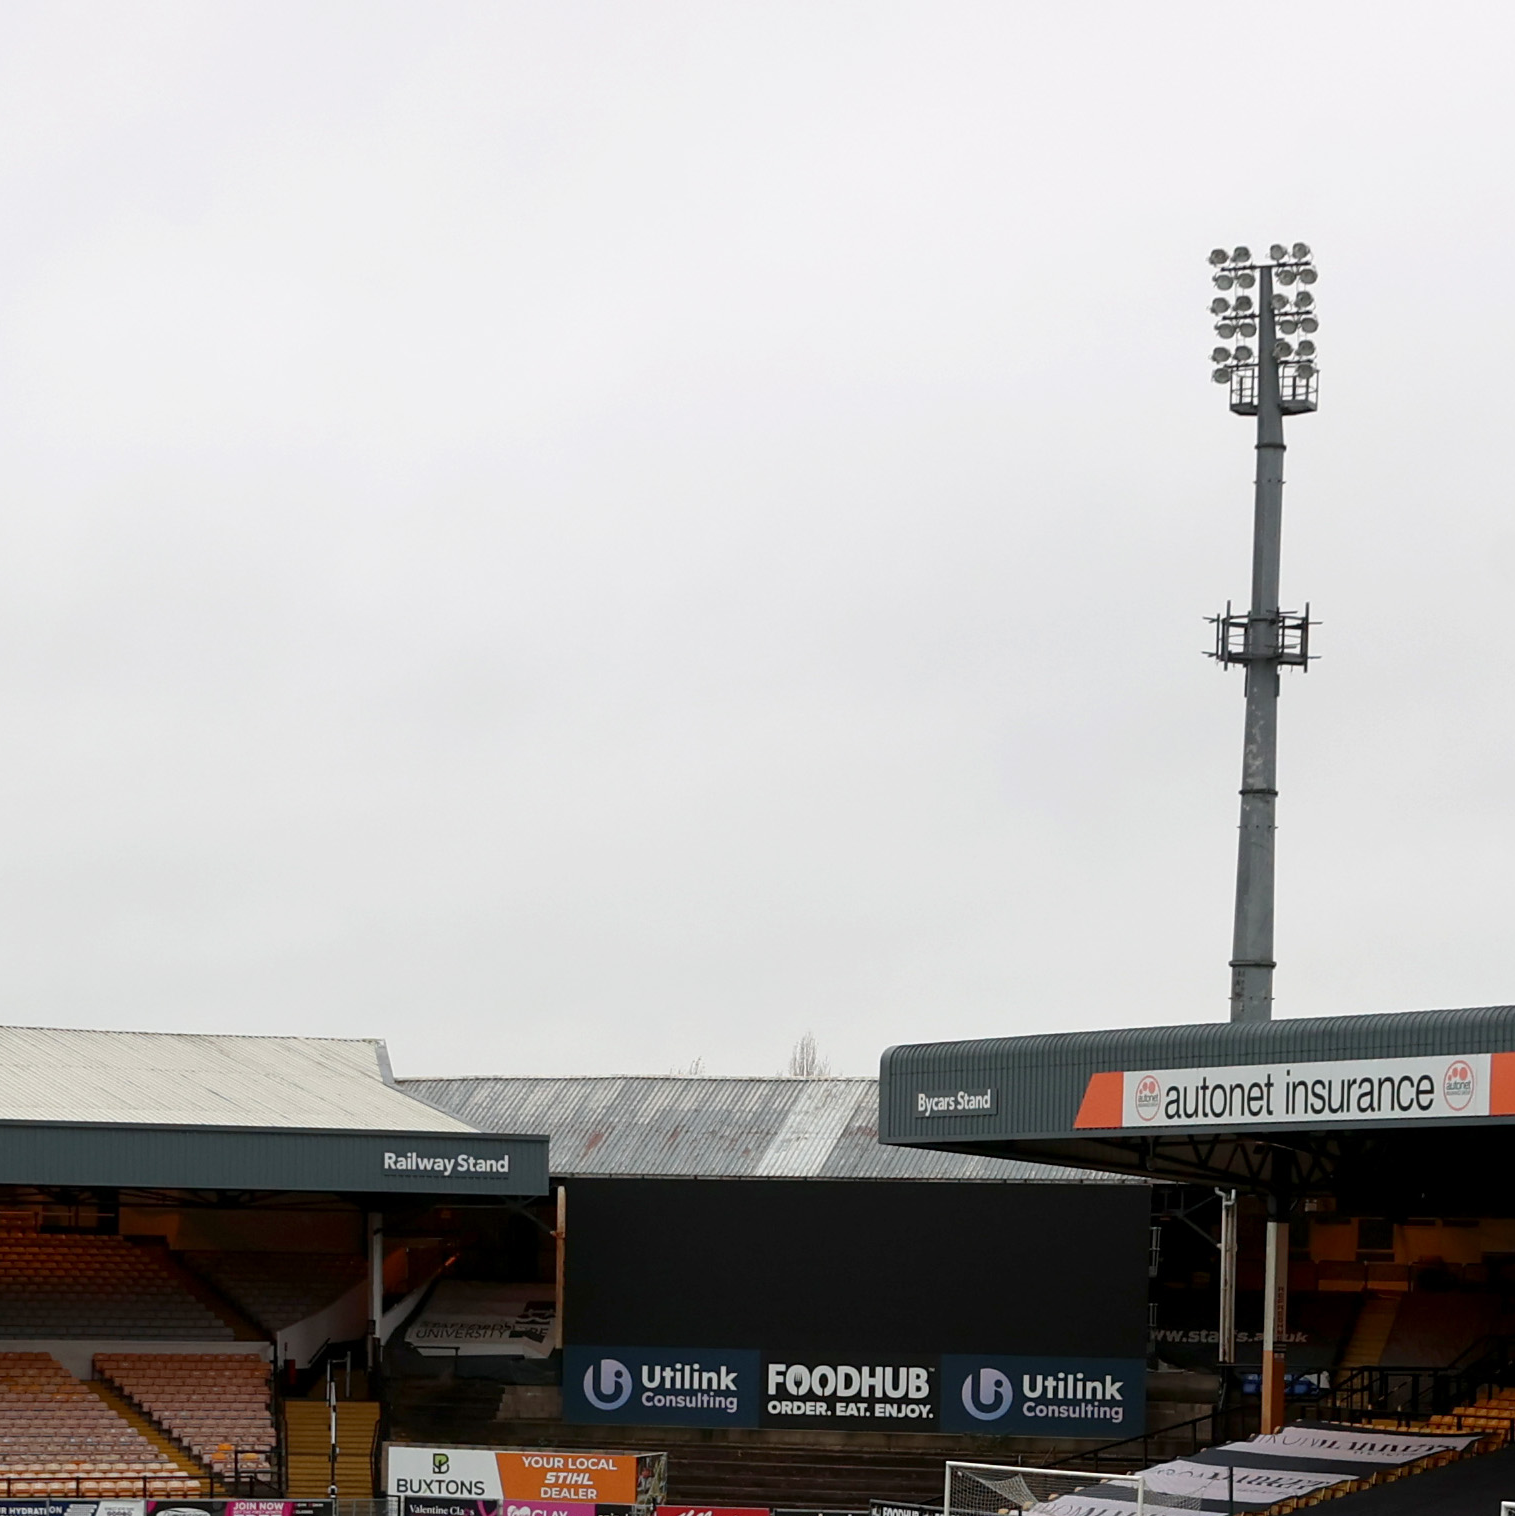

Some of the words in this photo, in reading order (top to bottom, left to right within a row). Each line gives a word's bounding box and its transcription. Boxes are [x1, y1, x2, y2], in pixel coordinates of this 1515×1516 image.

[917, 1092, 954, 1114] Bycars
[957, 1089, 991, 1110] Stand
[1165, 1074, 1274, 1120] autonet
[1285, 1070, 1434, 1115] insurance
[384, 1152, 455, 1176] Railway
[458, 1153, 509, 1174] Stand
[642, 1363, 738, 1391] Utilink
[767, 1364, 929, 1398] FOODHUB
[1022, 1374, 1123, 1402] Utilink
[642, 1392, 738, 1413] Consulting
[767, 1401, 831, 1417] ORDER.
[835, 1402, 871, 1417] EAT.
[874, 1402, 934, 1419] ENJOY.
[1022, 1401, 1123, 1422] Consulting
[522, 1456, 563, 1469] YOUR
[568, 1458, 617, 1471] LOCAL
[396, 1479, 485, 1496] BUXTONS
[544, 1472, 594, 1485] STIHL
[540, 1488, 597, 1499] DEALER
[233, 1502, 257, 1510] JOIN
[259, 1502, 284, 1510] NOW
[409, 1504, 448, 1515] Valentine
